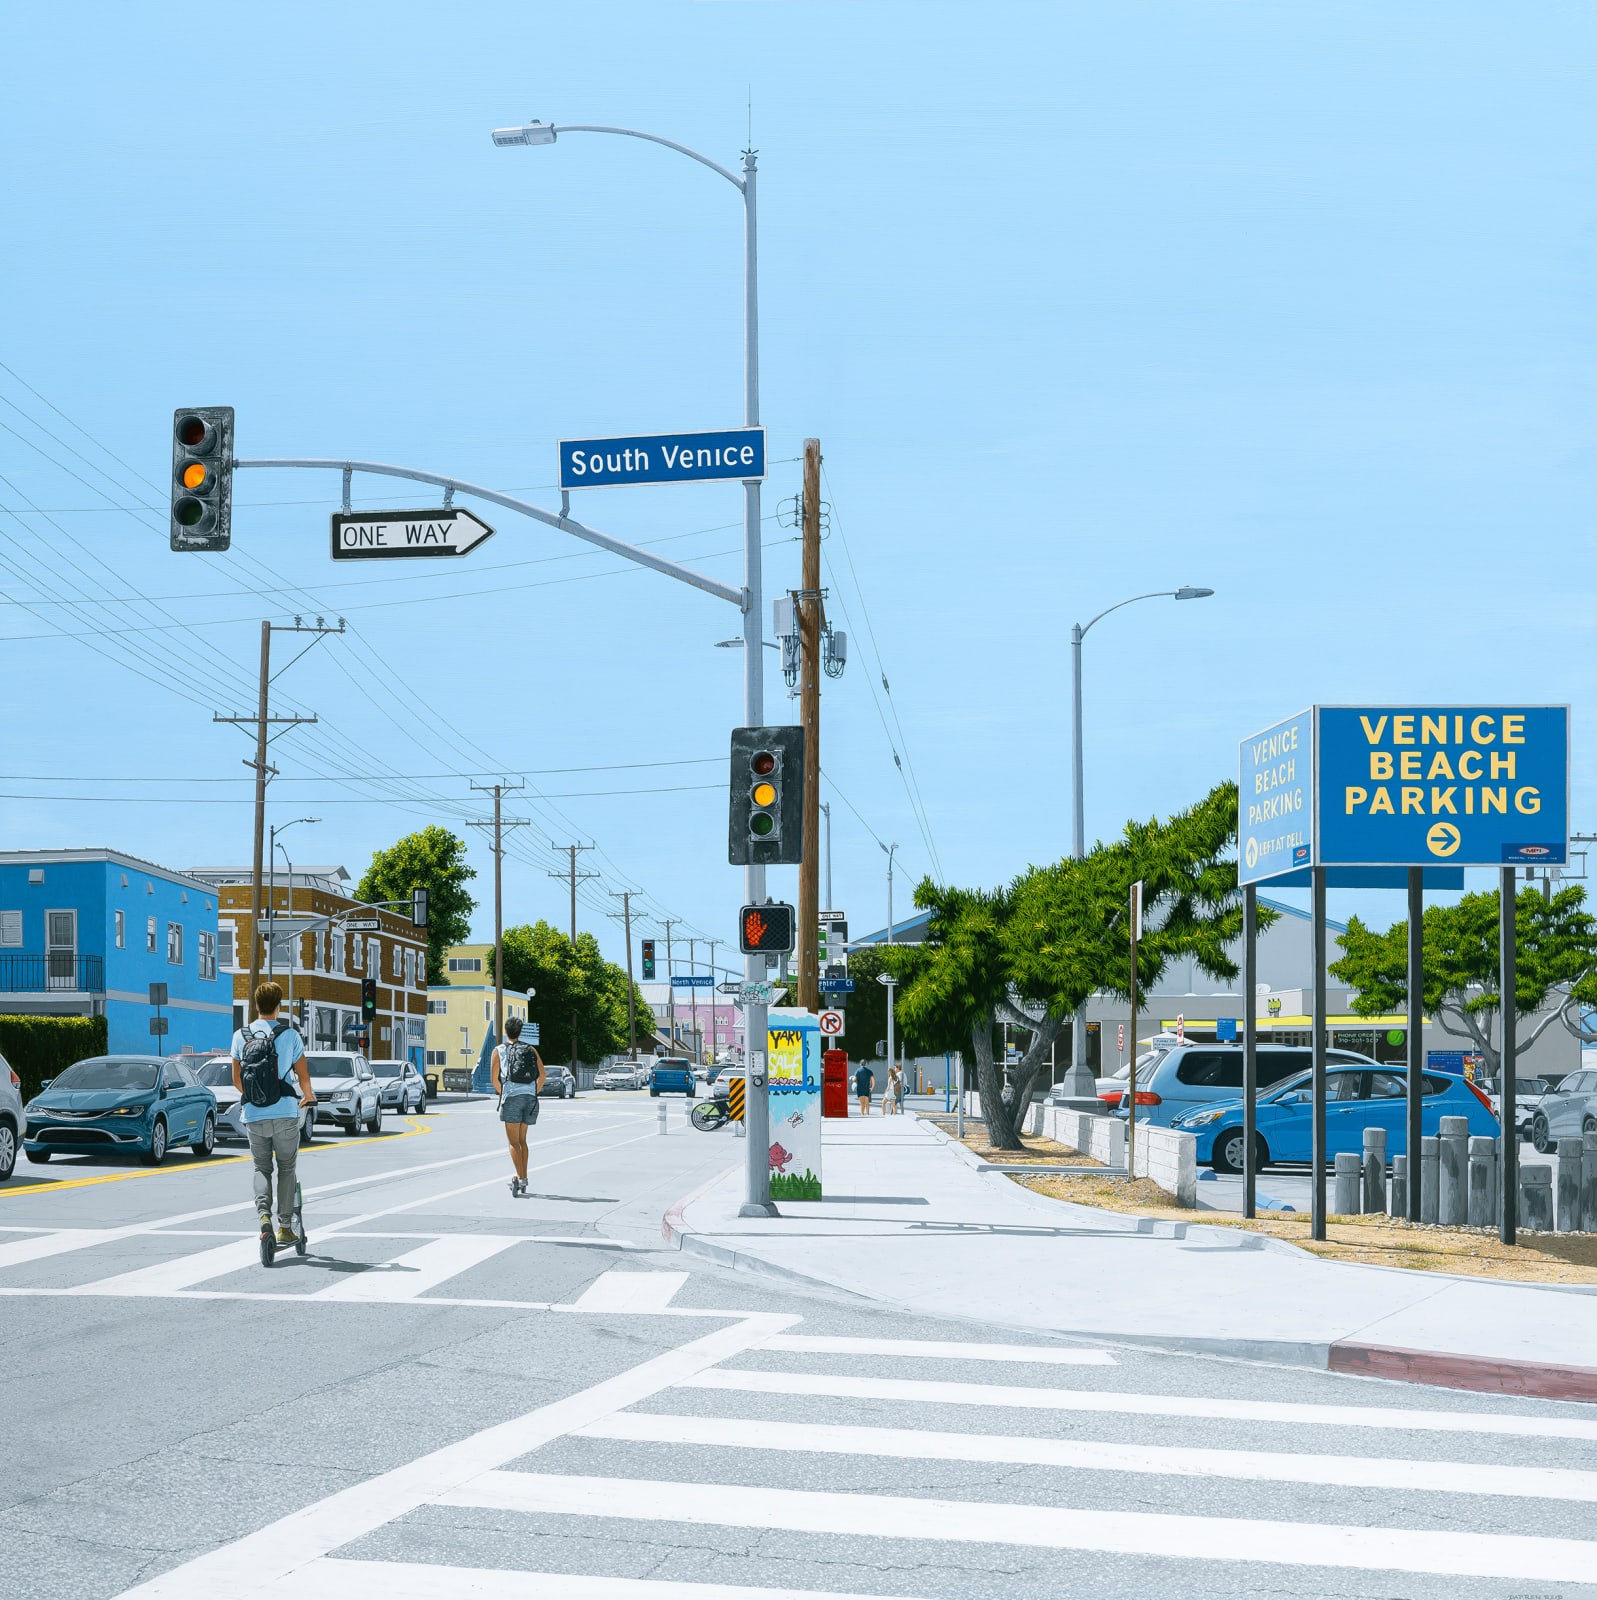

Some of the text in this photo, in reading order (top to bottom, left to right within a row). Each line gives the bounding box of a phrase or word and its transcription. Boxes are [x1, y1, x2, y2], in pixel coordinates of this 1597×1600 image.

[571, 445, 754, 476] South Venice
[343, 523, 452, 547] ONE WAY
[1359, 715, 1526, 745] VENICE
[1252, 726, 1299, 766] VENICE
[1255, 758, 1295, 795] BEACH
[1369, 750, 1516, 780] BEACH
[1249, 788, 1302, 827] PARKING
[1345, 786, 1541, 815] PARKING
[1259, 831, 1304, 857] LEFT AT DELL
[672, 978, 713, 986] North Venice
[769, 1030, 802, 1049] YARD
[767, 1053, 802, 1080] SALE
